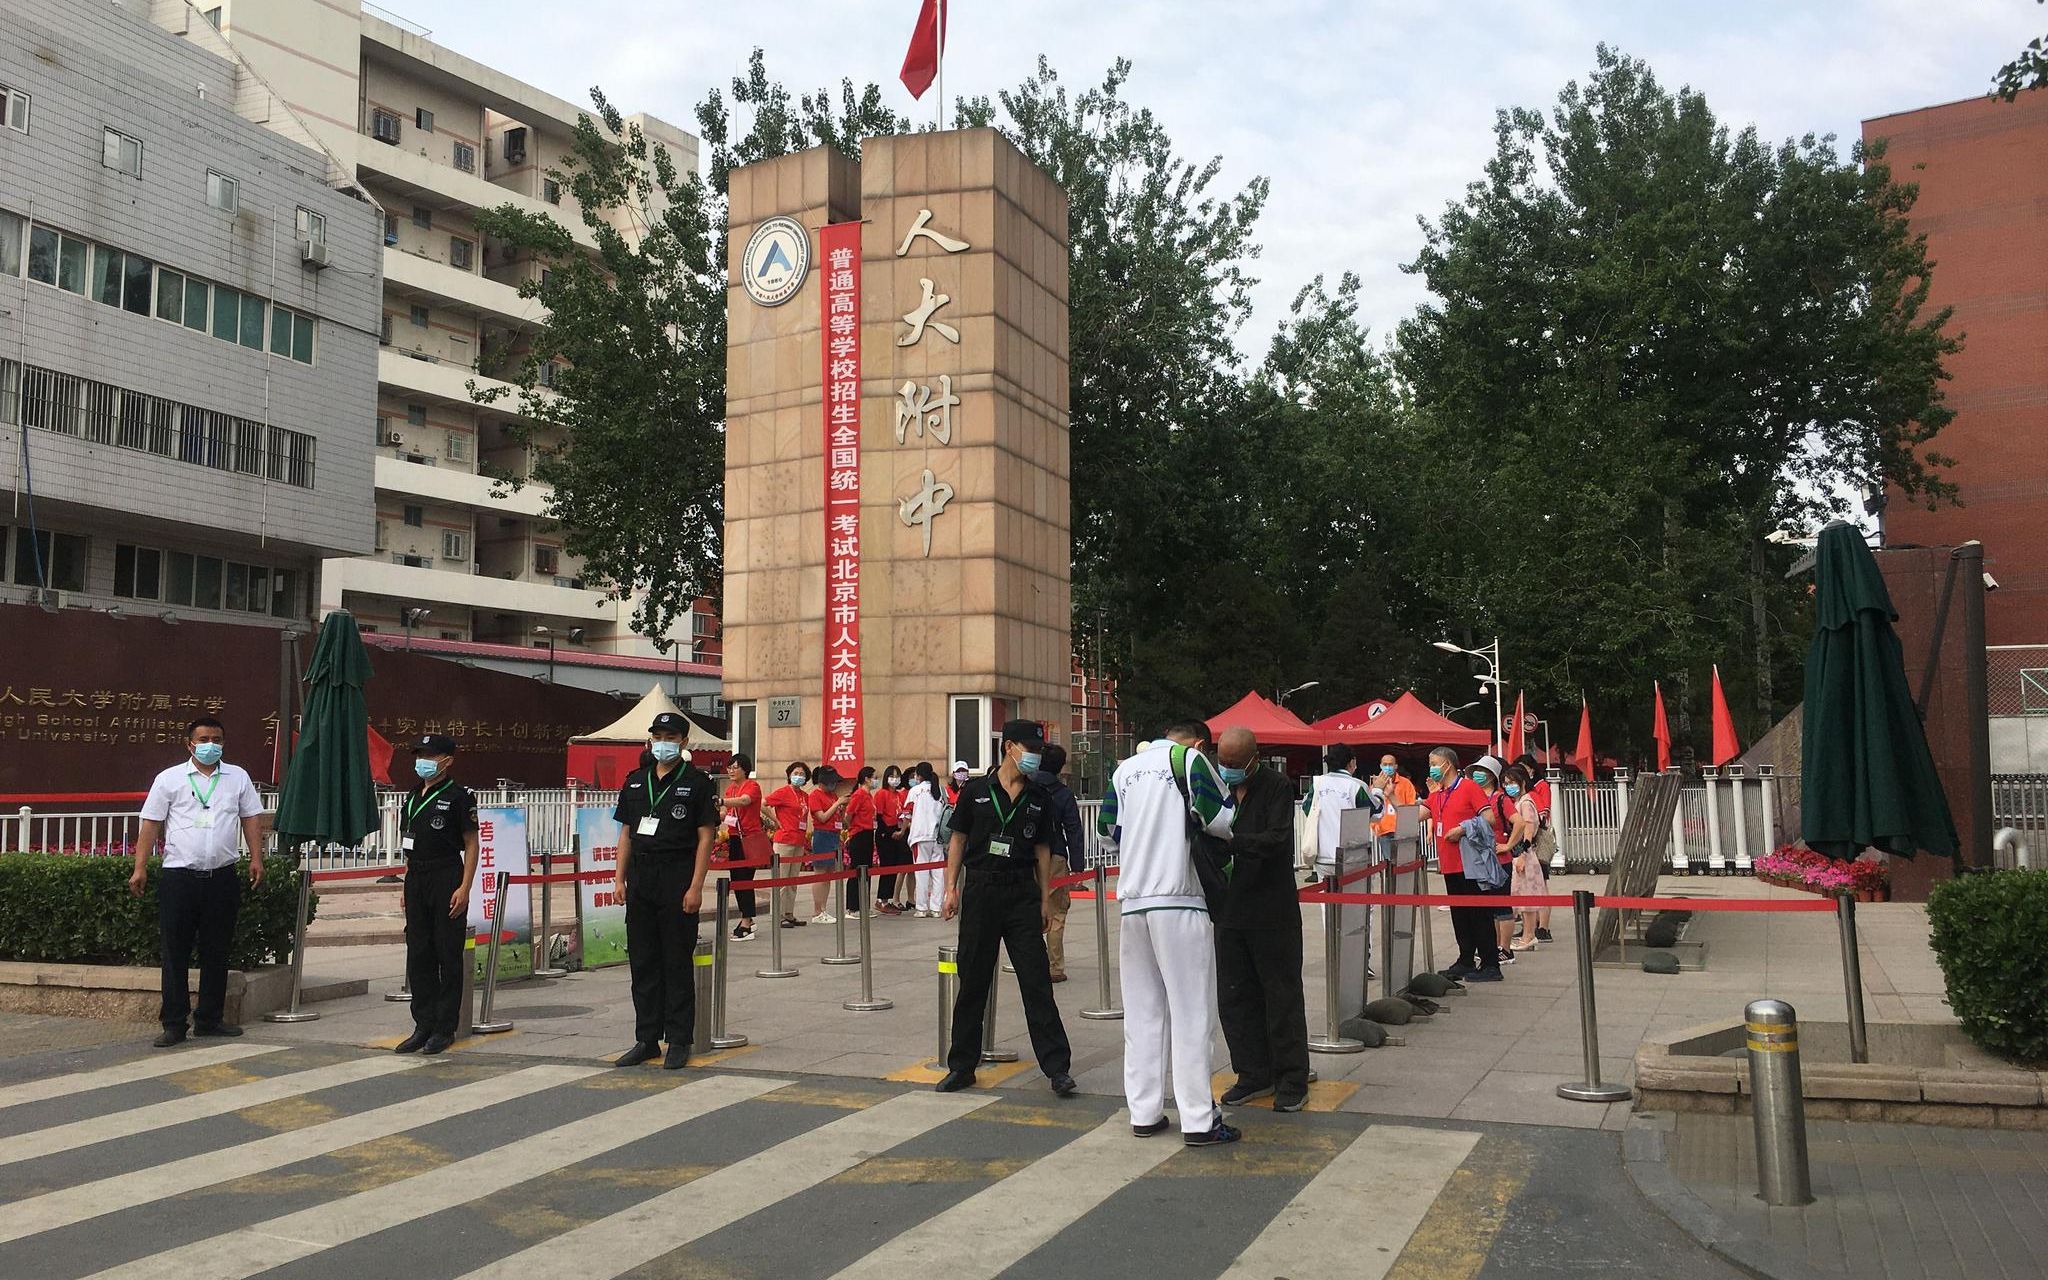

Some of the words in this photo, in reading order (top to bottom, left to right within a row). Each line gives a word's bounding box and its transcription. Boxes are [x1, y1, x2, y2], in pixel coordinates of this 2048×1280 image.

[895, 209, 970, 557] 人大附中
[829, 247, 859, 761] 普通高等学校招生全国统一考试北京市人大附中考点
[0, 686, 227, 714] 人民大学附属中学
[37, 714, 100, 727] School
[777, 710, 790, 721] 37
[18, 728, 119, 745] University
[128, 732, 146, 743] of
[480, 821, 496, 920] 考生通道
